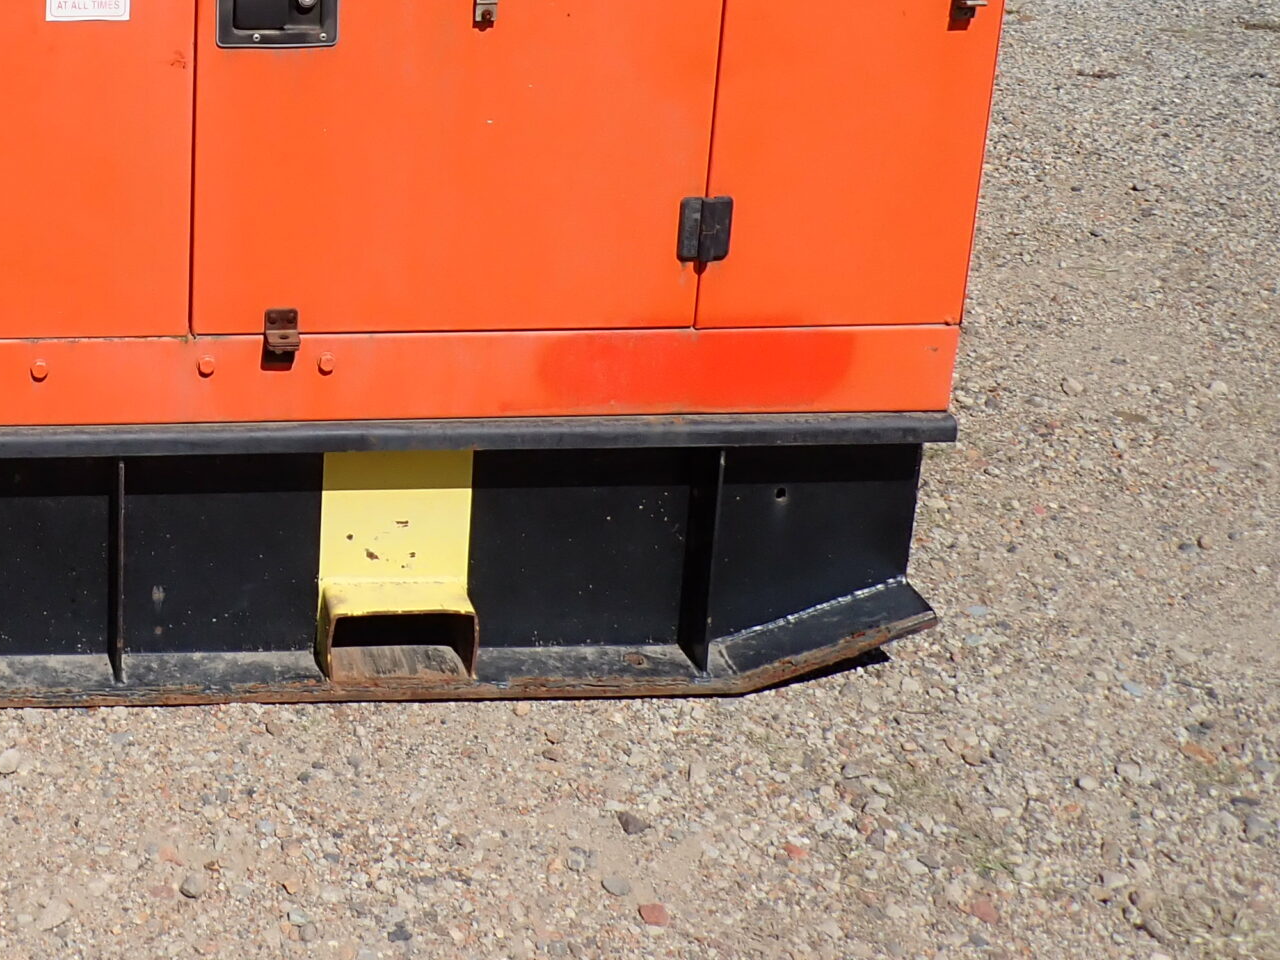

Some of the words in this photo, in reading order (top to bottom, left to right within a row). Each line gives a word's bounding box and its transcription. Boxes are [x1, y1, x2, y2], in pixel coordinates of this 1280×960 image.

[57, 0, 68, 10] AT
[71, 0, 89, 10] ALL
[92, 0, 120, 9] TIMES
